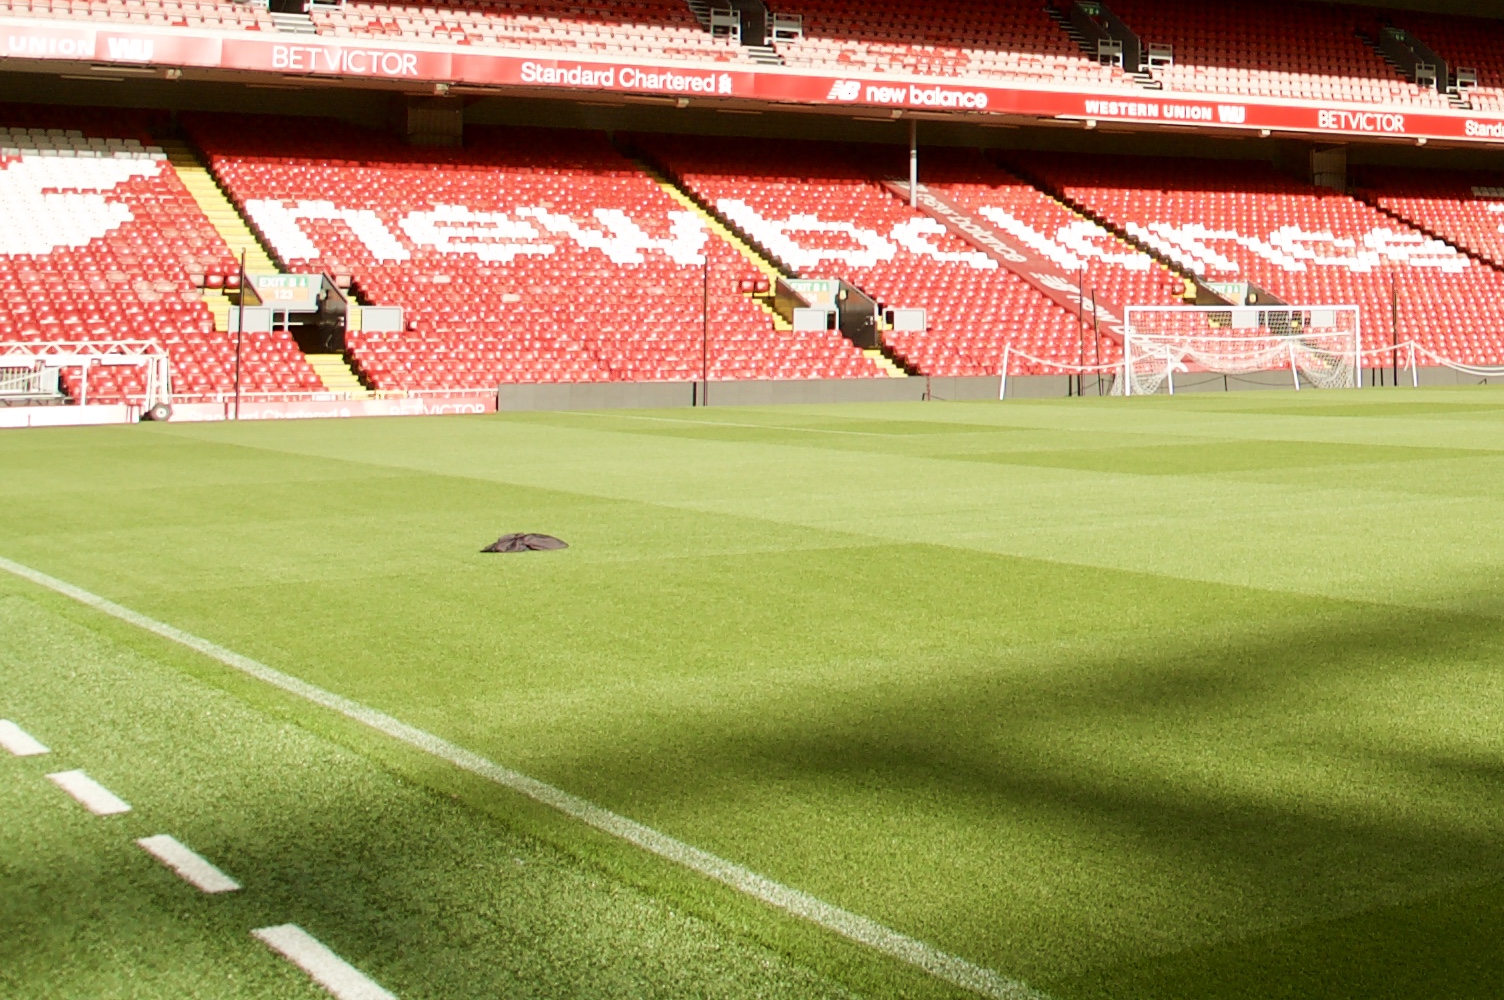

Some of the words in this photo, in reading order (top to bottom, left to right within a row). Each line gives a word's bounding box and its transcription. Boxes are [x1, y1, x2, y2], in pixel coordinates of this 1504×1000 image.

[8, 35, 95, 56] UNION
[108, 37, 154, 60] WU
[272, 46, 417, 75] BETVICTOR
[521, 62, 614, 87] Standard
[619, 68, 715, 92] Chartered
[866, 86, 906, 103] new
[909, 85, 988, 108] balance
[1085, 100, 1159, 117] WESTERN
[1163, 104, 1212, 120] UNION
[1218, 105, 1246, 123] WU
[1318, 110, 1405, 132] BETVICTOR
[259, 277, 287, 287] EXIT
